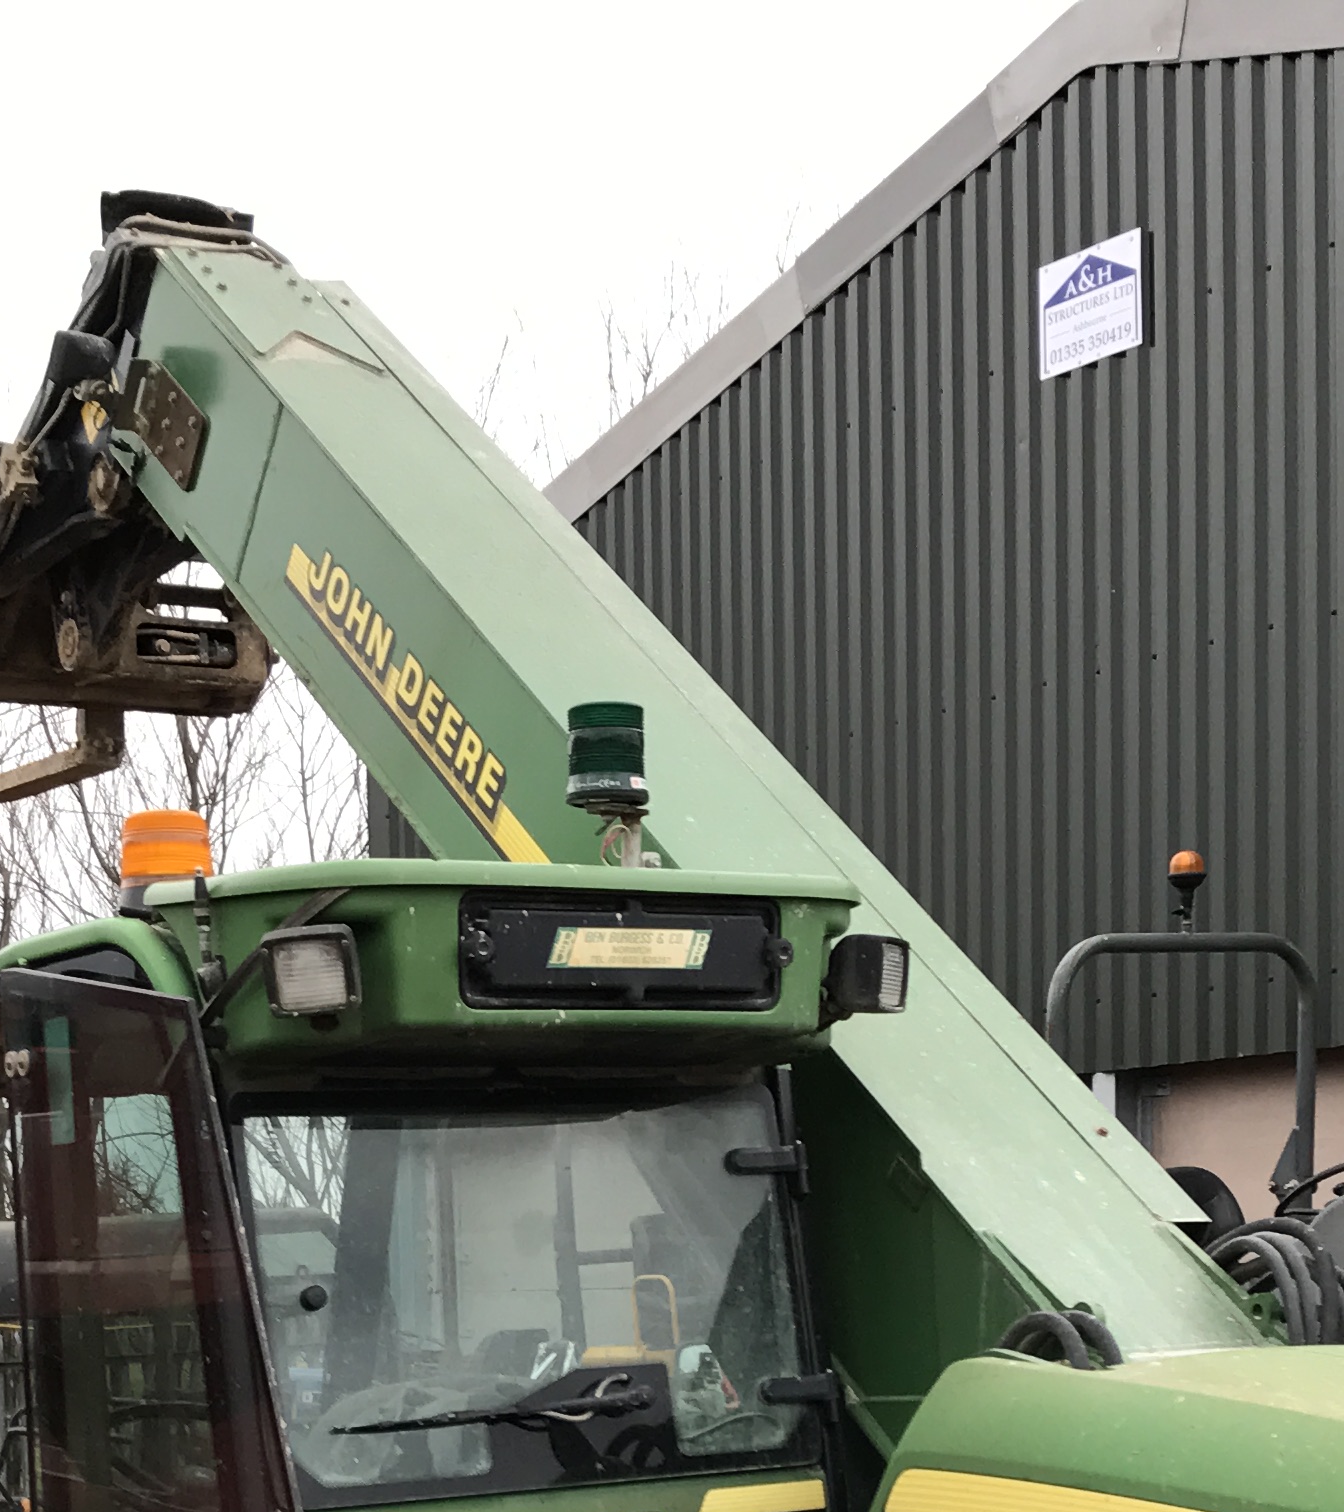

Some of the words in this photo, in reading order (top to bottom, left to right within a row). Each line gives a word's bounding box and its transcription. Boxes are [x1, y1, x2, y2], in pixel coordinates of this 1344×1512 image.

[1064, 263, 1113, 299] A&H
[1047, 291, 1109, 325] STRUCTURES
[1113, 283, 1133, 300] LTD
[1050, 339, 1084, 365] 01335
[1088, 322, 1131, 348] 350419
[308, 548, 395, 676] JOHN
[396, 651, 505, 814] DEERE
